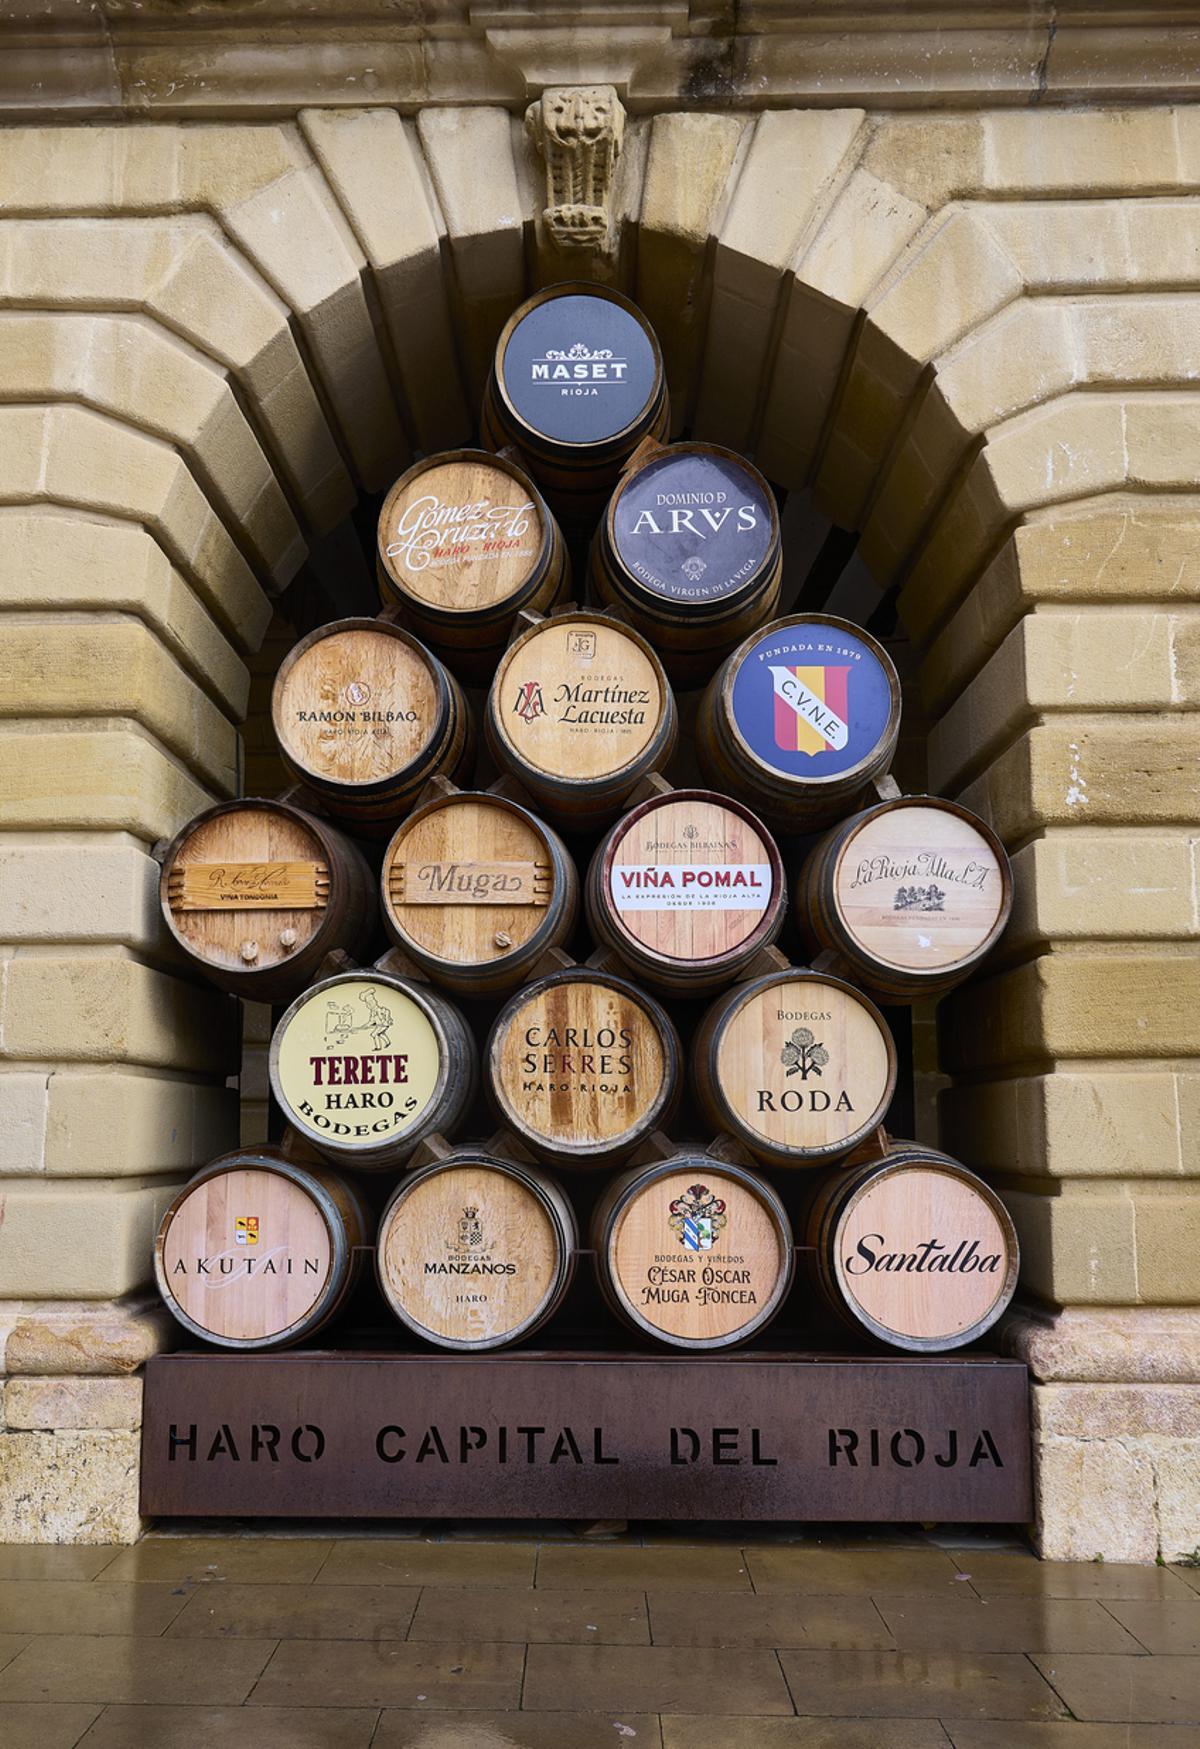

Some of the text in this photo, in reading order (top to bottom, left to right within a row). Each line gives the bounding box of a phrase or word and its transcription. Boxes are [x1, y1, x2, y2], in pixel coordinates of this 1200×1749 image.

[531, 363, 628, 380] MASET
[561, 388, 599, 396] RIOJA
[656, 492, 714, 506] DOMINIO
[386, 495, 491, 557] Gómez
[483, 538, 521, 551] RIOJA
[632, 560, 667, 590] BODEGA
[671, 585, 710, 597] VIRGEN
[724, 579, 737, 588] LA
[733, 559, 757, 580] VEGA
[758, 643, 862, 662] FUNDADA EN 1879
[553, 682, 651, 704] Martínez
[360, 710, 418, 722] BILBAO
[558, 705, 646, 725] Lacuesta
[781, 679, 840, 740] C.V.N.E.
[417, 864, 523, 899] Muga
[620, 867, 763, 888] VIÑA POMAL
[849, 859, 873, 890] La
[870, 855, 918, 881] Rioja
[776, 1008, 833, 1021] BODEGAS
[525, 1027, 633, 1049] CARLOS
[309, 1054, 409, 1086] TERETE
[523, 1053, 633, 1075] SERRES
[325, 1091, 394, 1110] HARO
[756, 1089, 855, 1113] RODA
[297, 1096, 419, 1137] BODEGAS
[447, 1254, 493, 1262] BODEGAS
[654, 1254, 745, 1264] BODEGAS Y VIÑEDOS
[845, 1233, 1003, 1276] Santalba
[173, 1257, 320, 1274] AKUTAIN
[424, 1262, 517, 1275] MANZANOS
[647, 1263, 751, 1287] CÉSAR ÓSCAR
[455, 1295, 489, 1303] HARO
[640, 1286, 690, 1306] MUGA
[168, 1423, 1005, 1468] HARO CAPITAL DEL RIOJA
